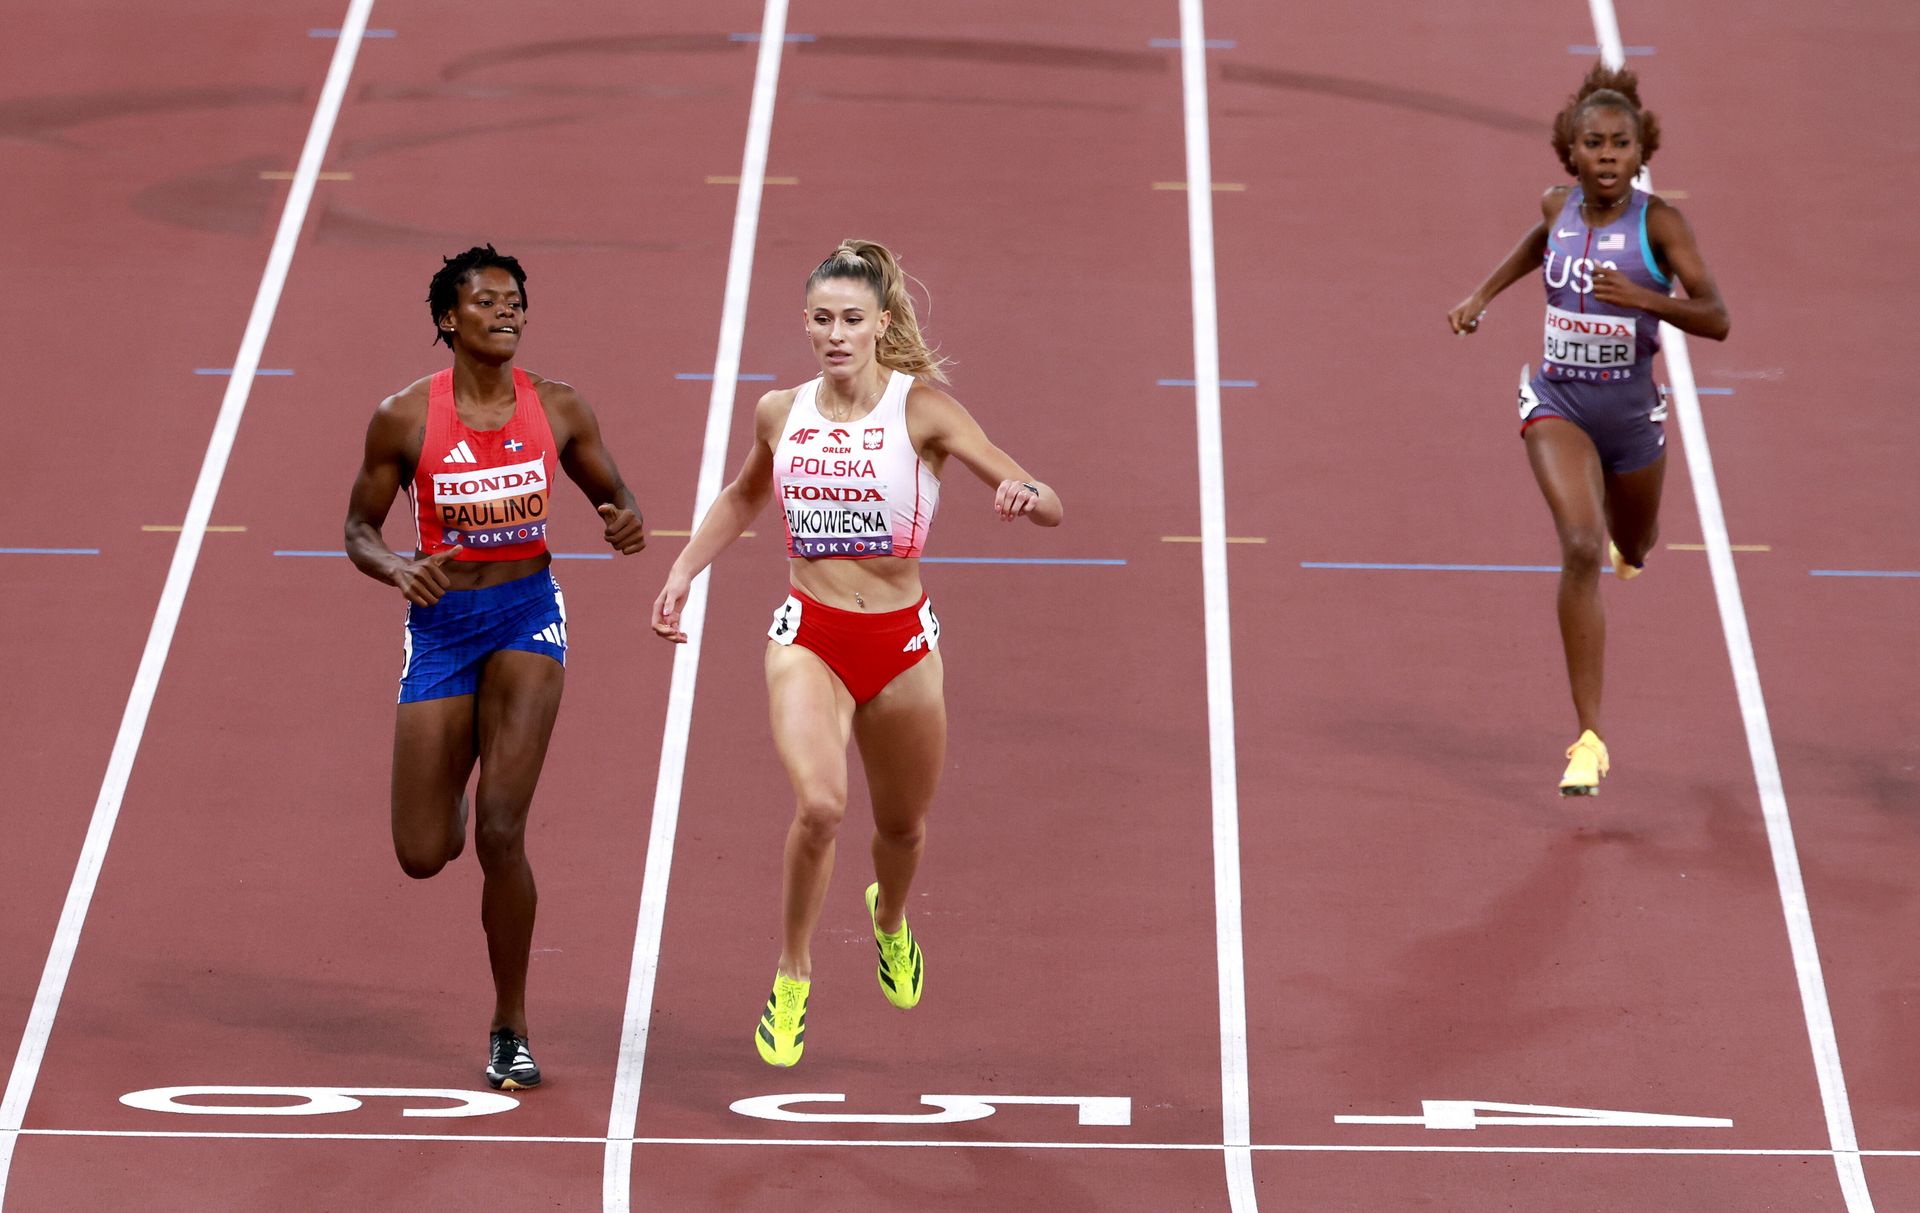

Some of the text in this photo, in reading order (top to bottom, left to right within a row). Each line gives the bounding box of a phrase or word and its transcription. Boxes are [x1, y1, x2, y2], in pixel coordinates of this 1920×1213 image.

[1548, 313, 1631, 337] HONDA
[789, 428, 820, 444] 4F
[822, 446, 851, 454] ORLEN
[790, 456, 877, 479] POLSKA
[437, 470, 544, 496] HONDA
[783, 485, 886, 502] HONDA
[442, 494, 543, 527] PAULINO
[118, 1085, 521, 1118] 6
[729, 1093, 1132, 1127] 5
[1333, 1100, 1733, 1131] 4
